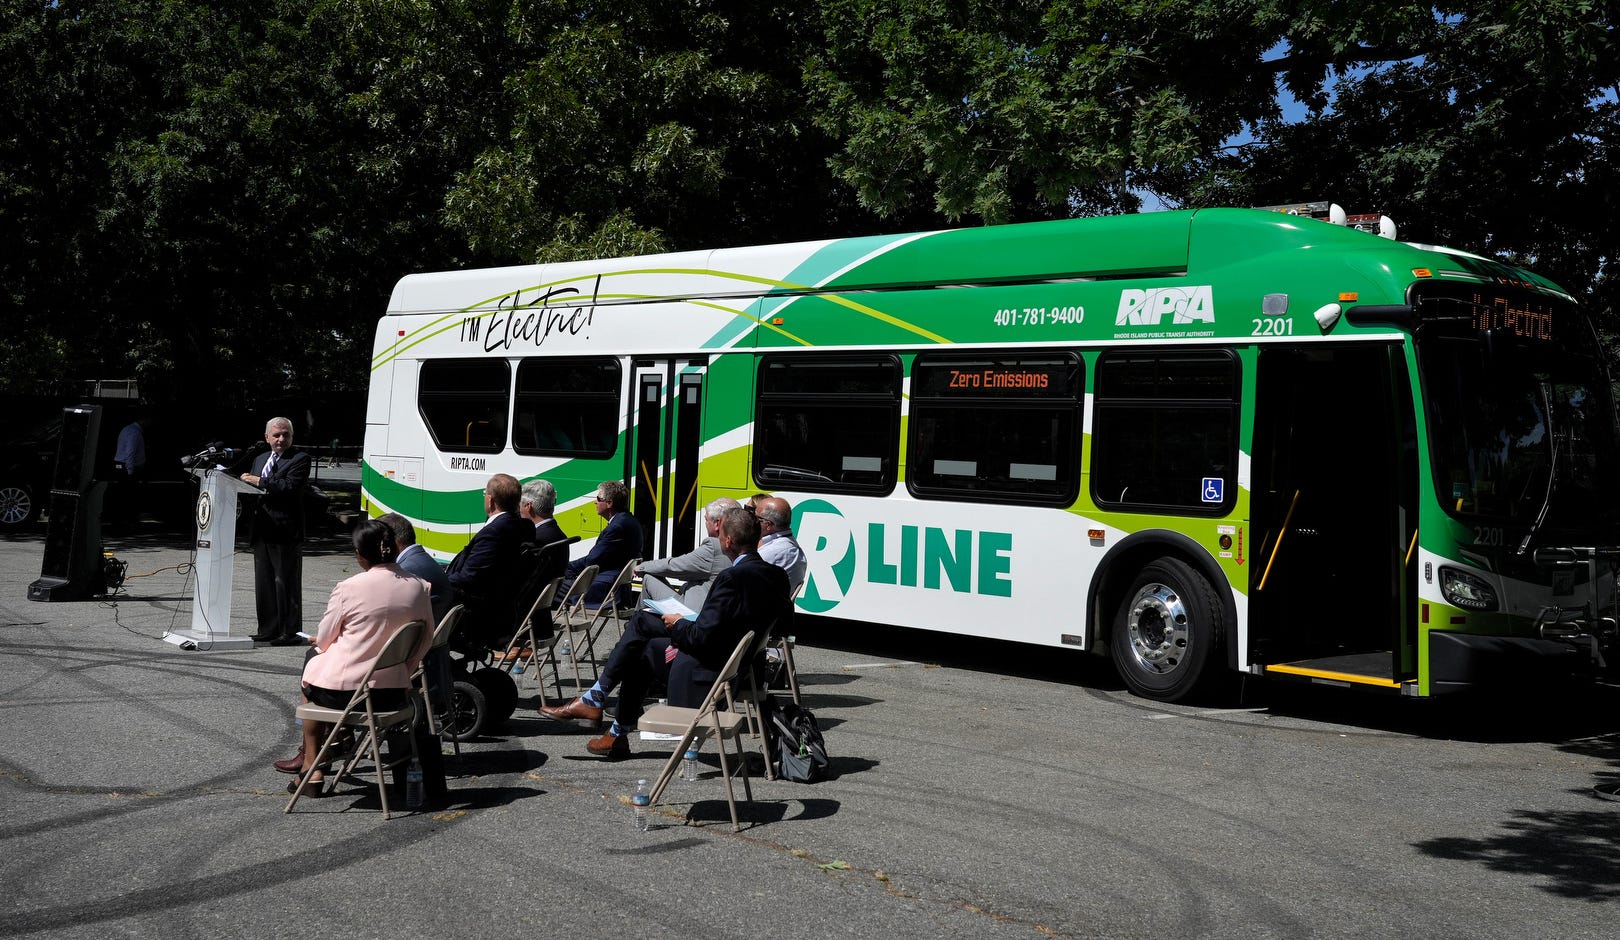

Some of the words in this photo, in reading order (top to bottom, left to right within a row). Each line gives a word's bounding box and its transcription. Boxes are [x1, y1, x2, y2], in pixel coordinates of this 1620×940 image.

[460, 316, 481, 342] I'M
[484, 274, 601, 352] Electric!
[1115, 285, 1215, 326] RIPTA
[993, 306, 1085, 327] 401-781-9400
[1251, 318, 1294, 336] 2201
[950, 370, 980, 388] Zero
[984, 370, 1048, 388] Emissions
[450, 456, 486, 471] RIPTA.COM
[1473, 526, 1504, 546] 2201
[795, 511, 852, 602] R
[867, 522, 1012, 598] LINE
